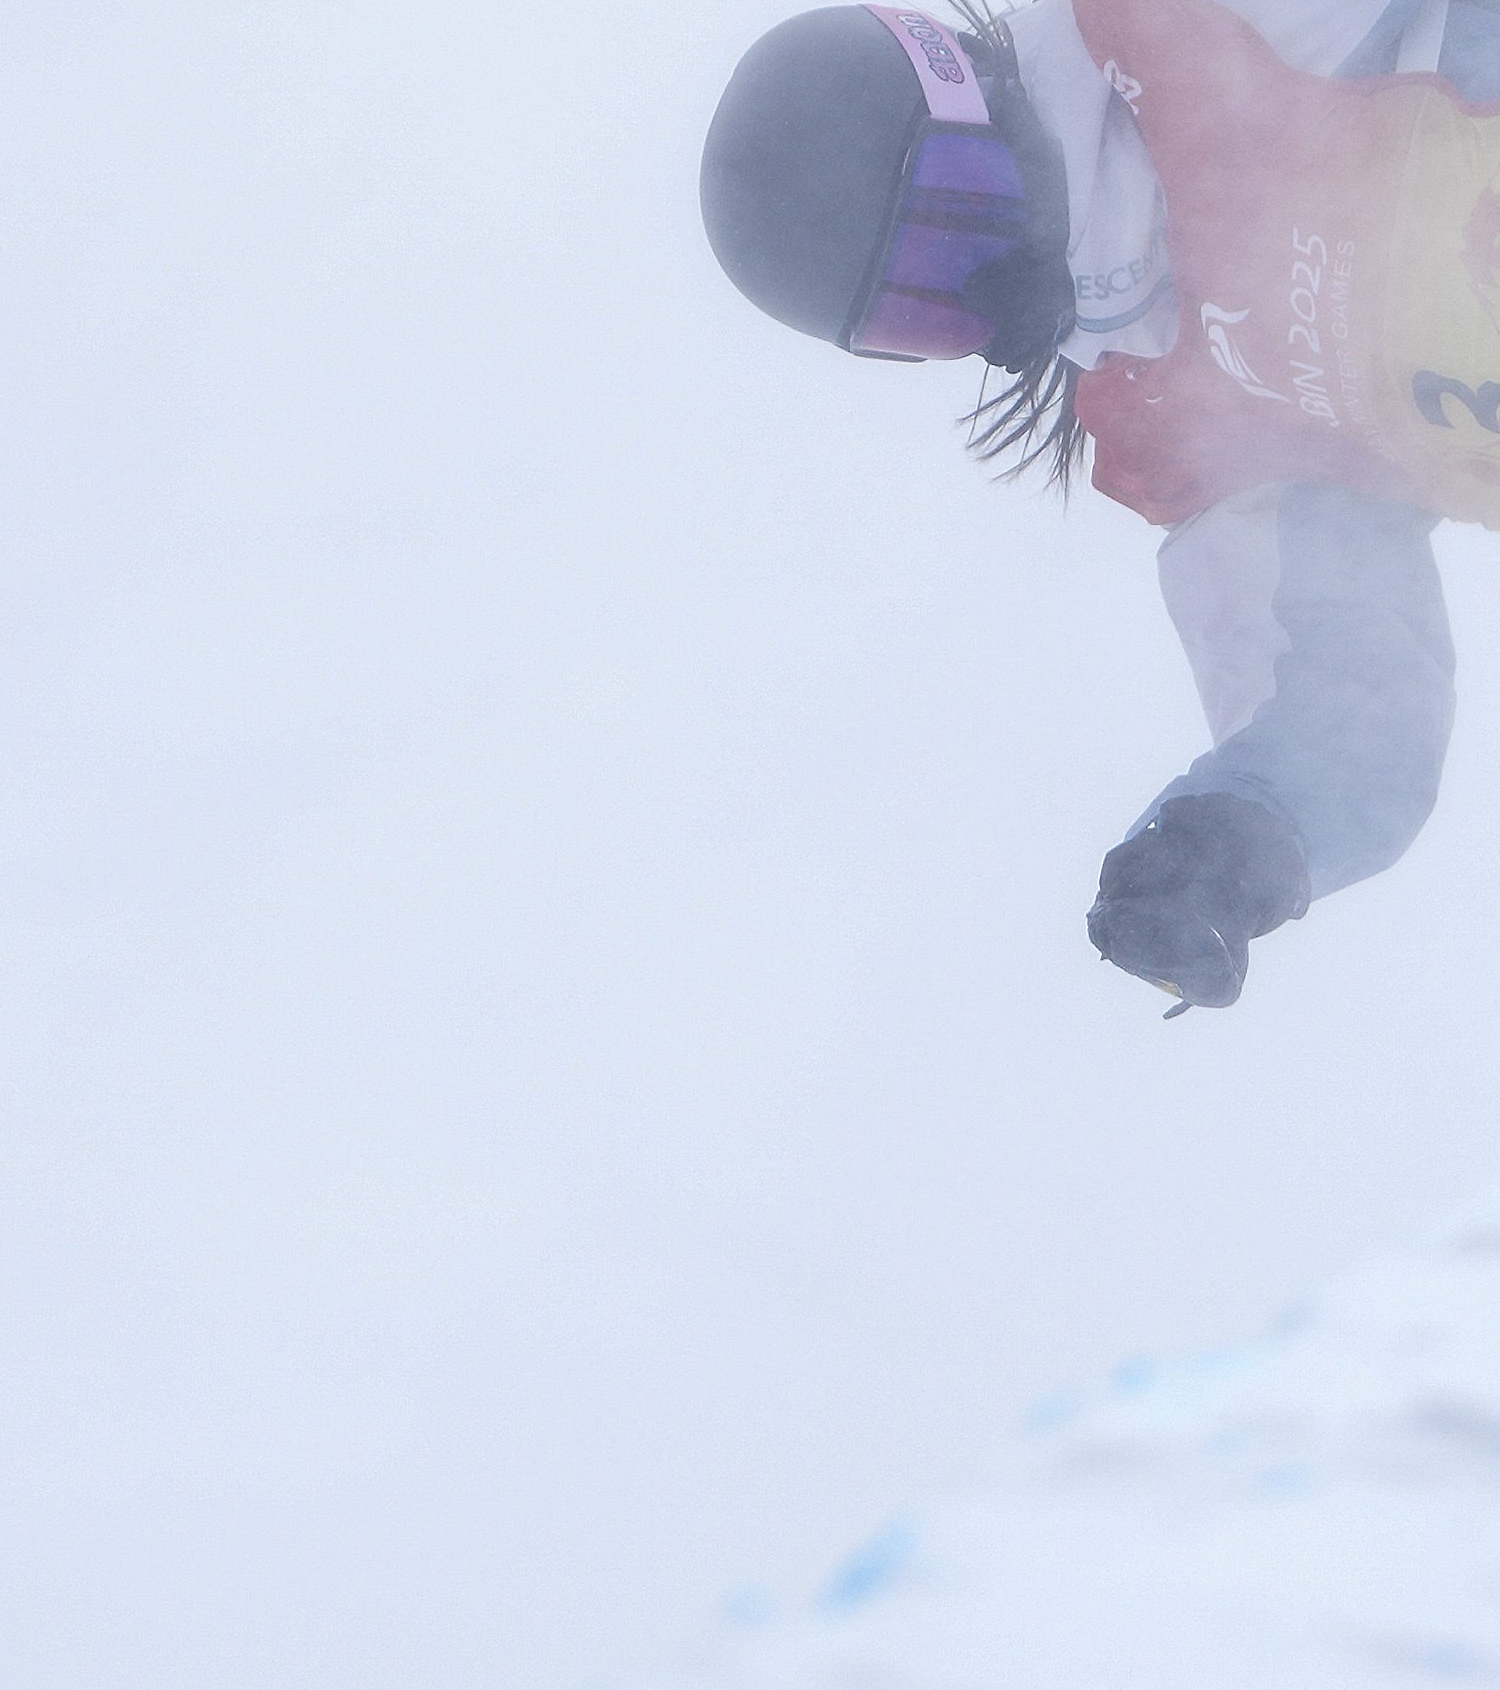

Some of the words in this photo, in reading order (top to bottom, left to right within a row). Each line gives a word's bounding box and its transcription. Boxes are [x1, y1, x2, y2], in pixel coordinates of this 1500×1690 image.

[1288, 226, 1328, 354] 2025
[1331, 240, 1356, 340] GAMES
[1289, 360, 1340, 428] BIN
